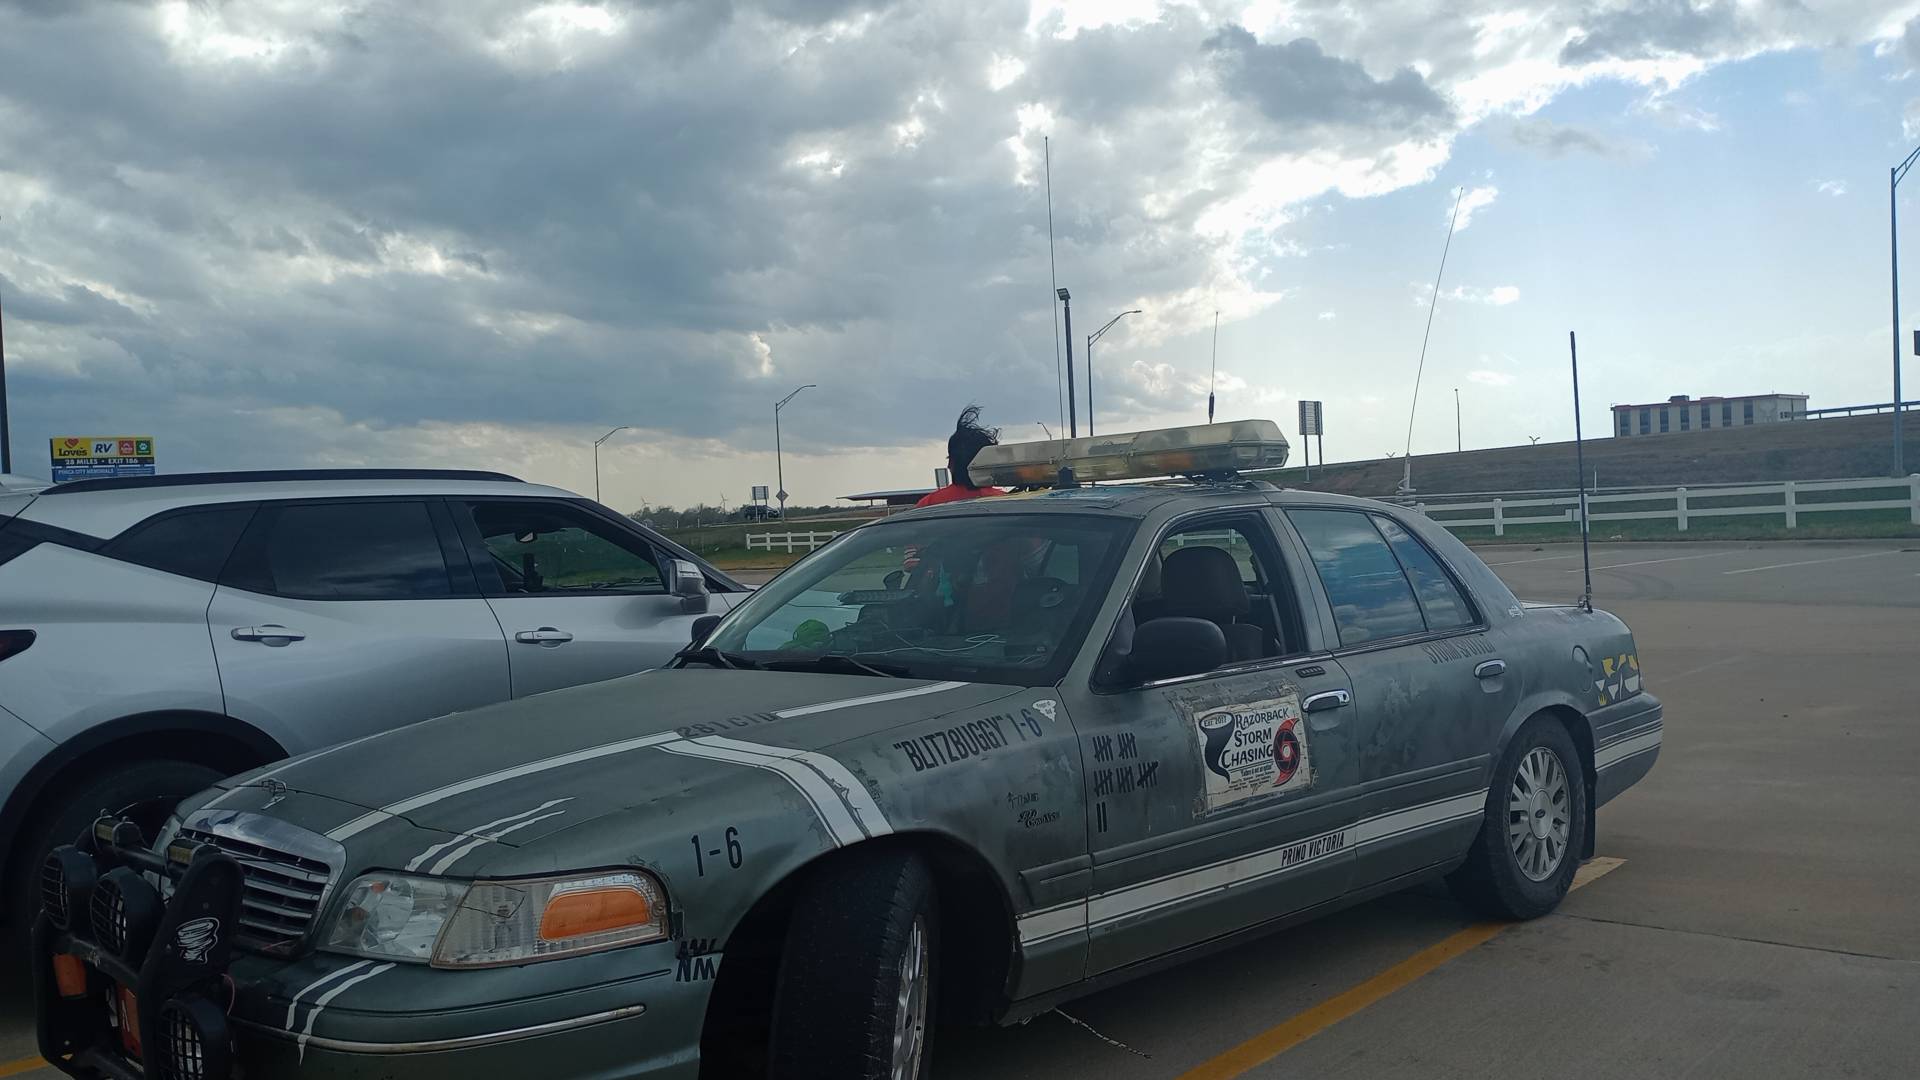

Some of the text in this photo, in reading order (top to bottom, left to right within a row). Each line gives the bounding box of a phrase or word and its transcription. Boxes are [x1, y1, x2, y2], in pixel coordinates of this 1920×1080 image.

[58, 448, 88, 457] Love's
[94, 443, 113, 454] RV
[1006, 708, 1043, 741] 1-6
[1235, 707, 1290, 730] RAZORBACK
[1234, 727, 1272, 748] STORM
[1221, 743, 1275, 769] CHASING
[691, 826, 743, 877] 1-6
[1281, 831, 1345, 867] PRIMO VICTORIA
